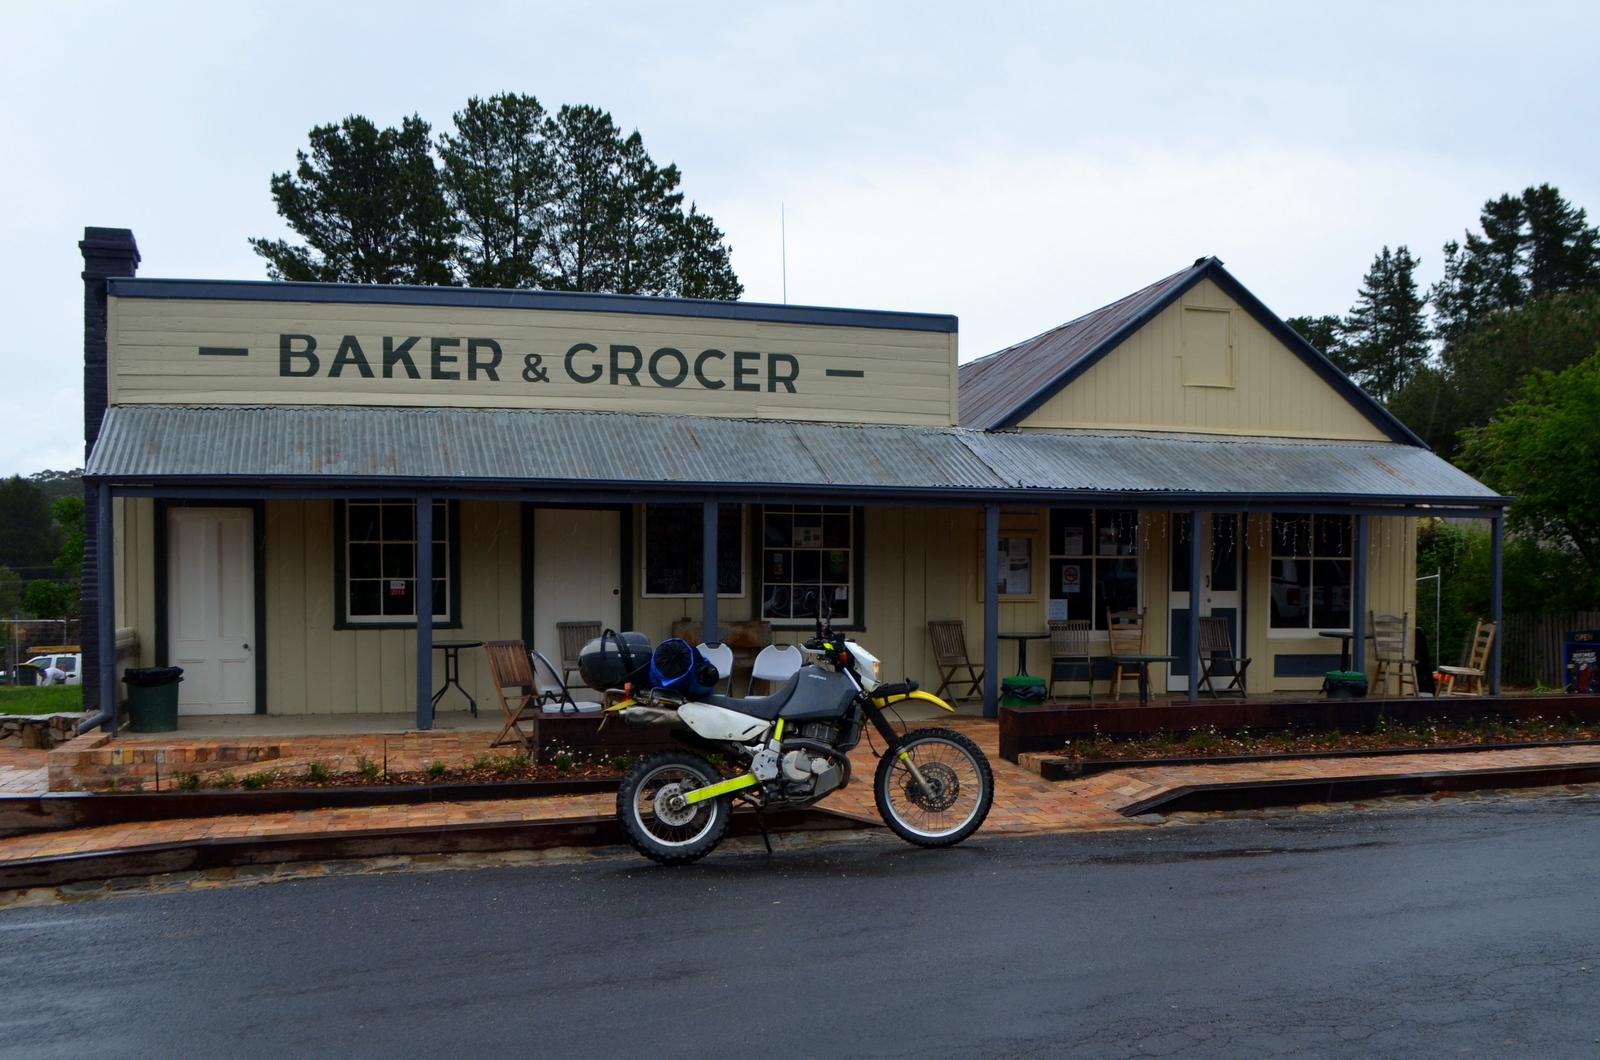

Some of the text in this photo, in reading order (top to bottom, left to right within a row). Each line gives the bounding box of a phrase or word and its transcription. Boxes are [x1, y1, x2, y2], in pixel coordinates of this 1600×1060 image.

[279, 333, 800, 394] BAKER & GROCER
[1574, 633, 1593, 641] OPEN
